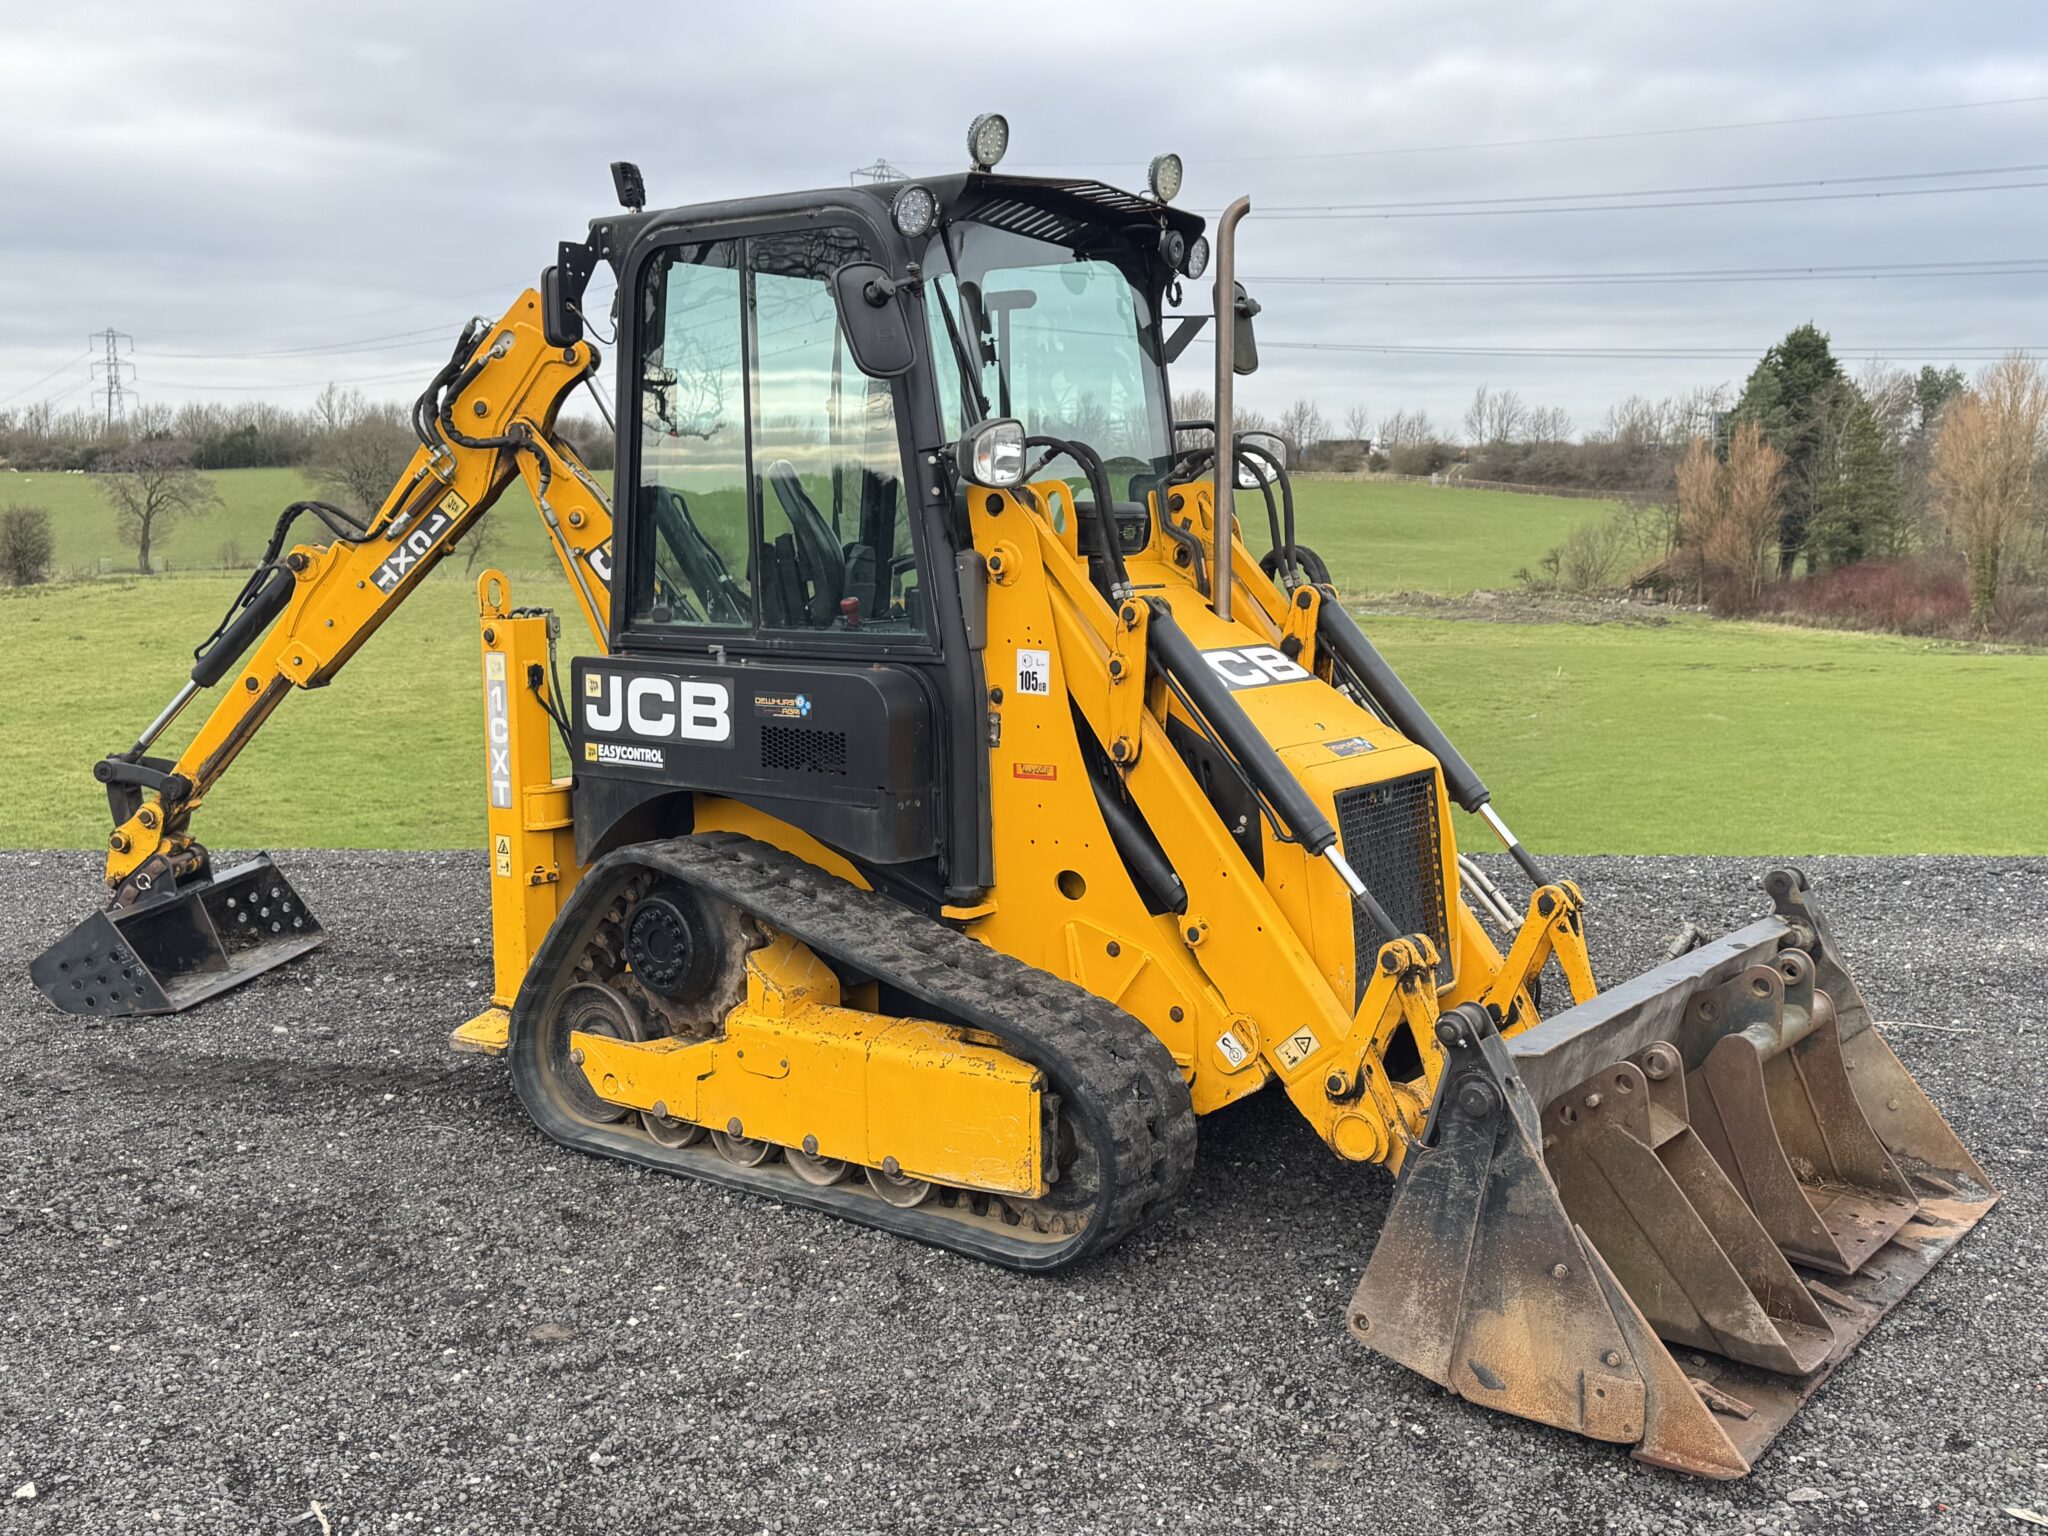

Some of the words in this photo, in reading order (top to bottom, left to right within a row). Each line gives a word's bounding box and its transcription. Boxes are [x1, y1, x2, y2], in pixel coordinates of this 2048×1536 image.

[377, 514, 447, 587] 1CXT
[1201, 647, 1310, 688] CB
[585, 675, 731, 742] JCB
[490, 687, 509, 805] 1CXT
[598, 743, 664, 763] EASYCONTROL
